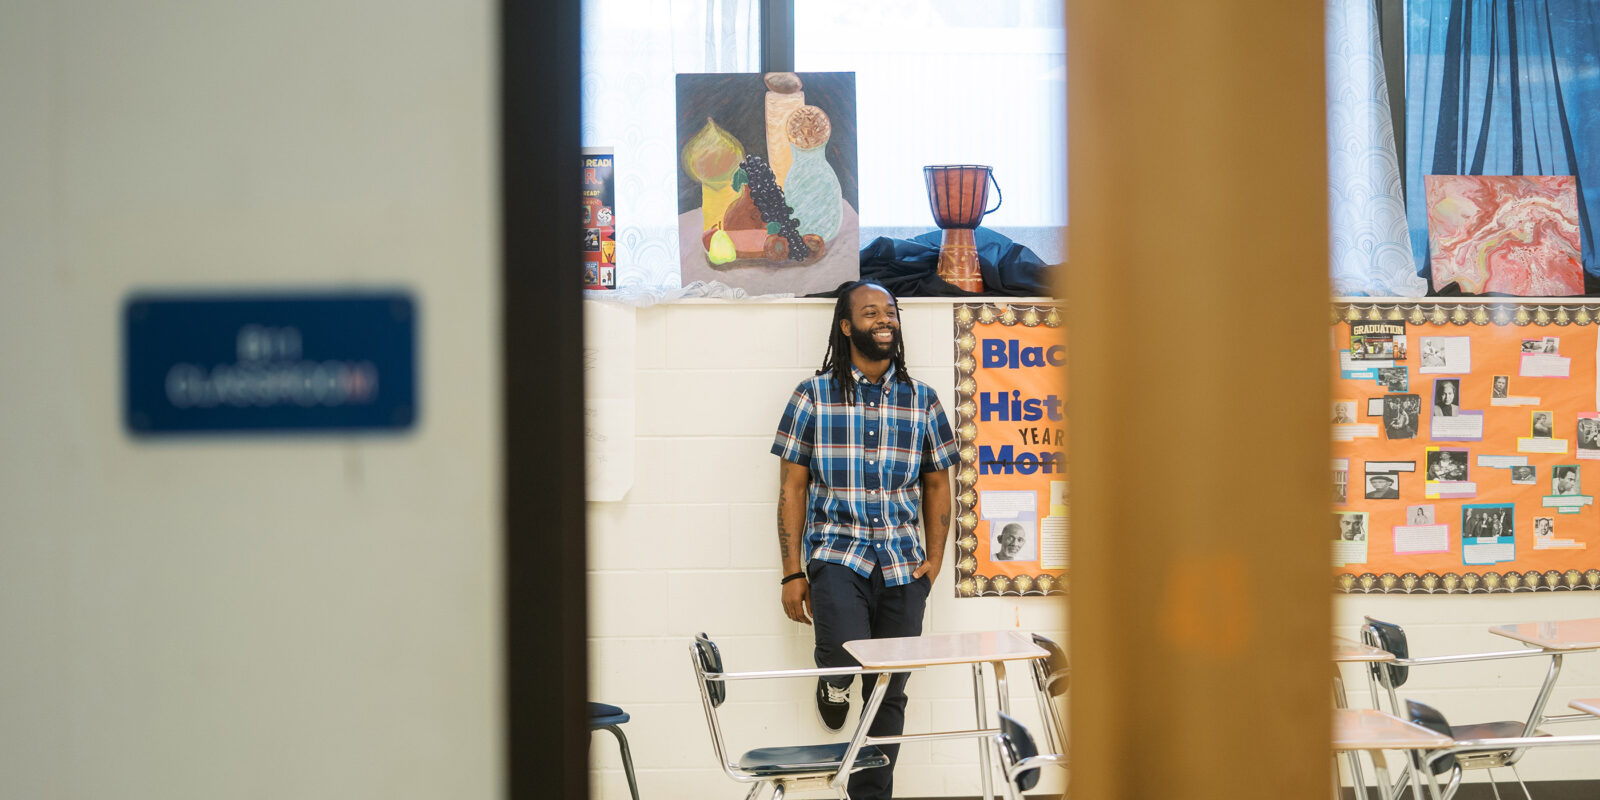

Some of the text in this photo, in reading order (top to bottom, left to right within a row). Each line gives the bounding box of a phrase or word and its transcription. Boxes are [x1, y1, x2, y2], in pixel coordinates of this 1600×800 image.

[1353, 324, 1404, 335] GRADUATION
[980, 389, 1070, 422] Hist
[1018, 427, 1064, 446] YEAR
